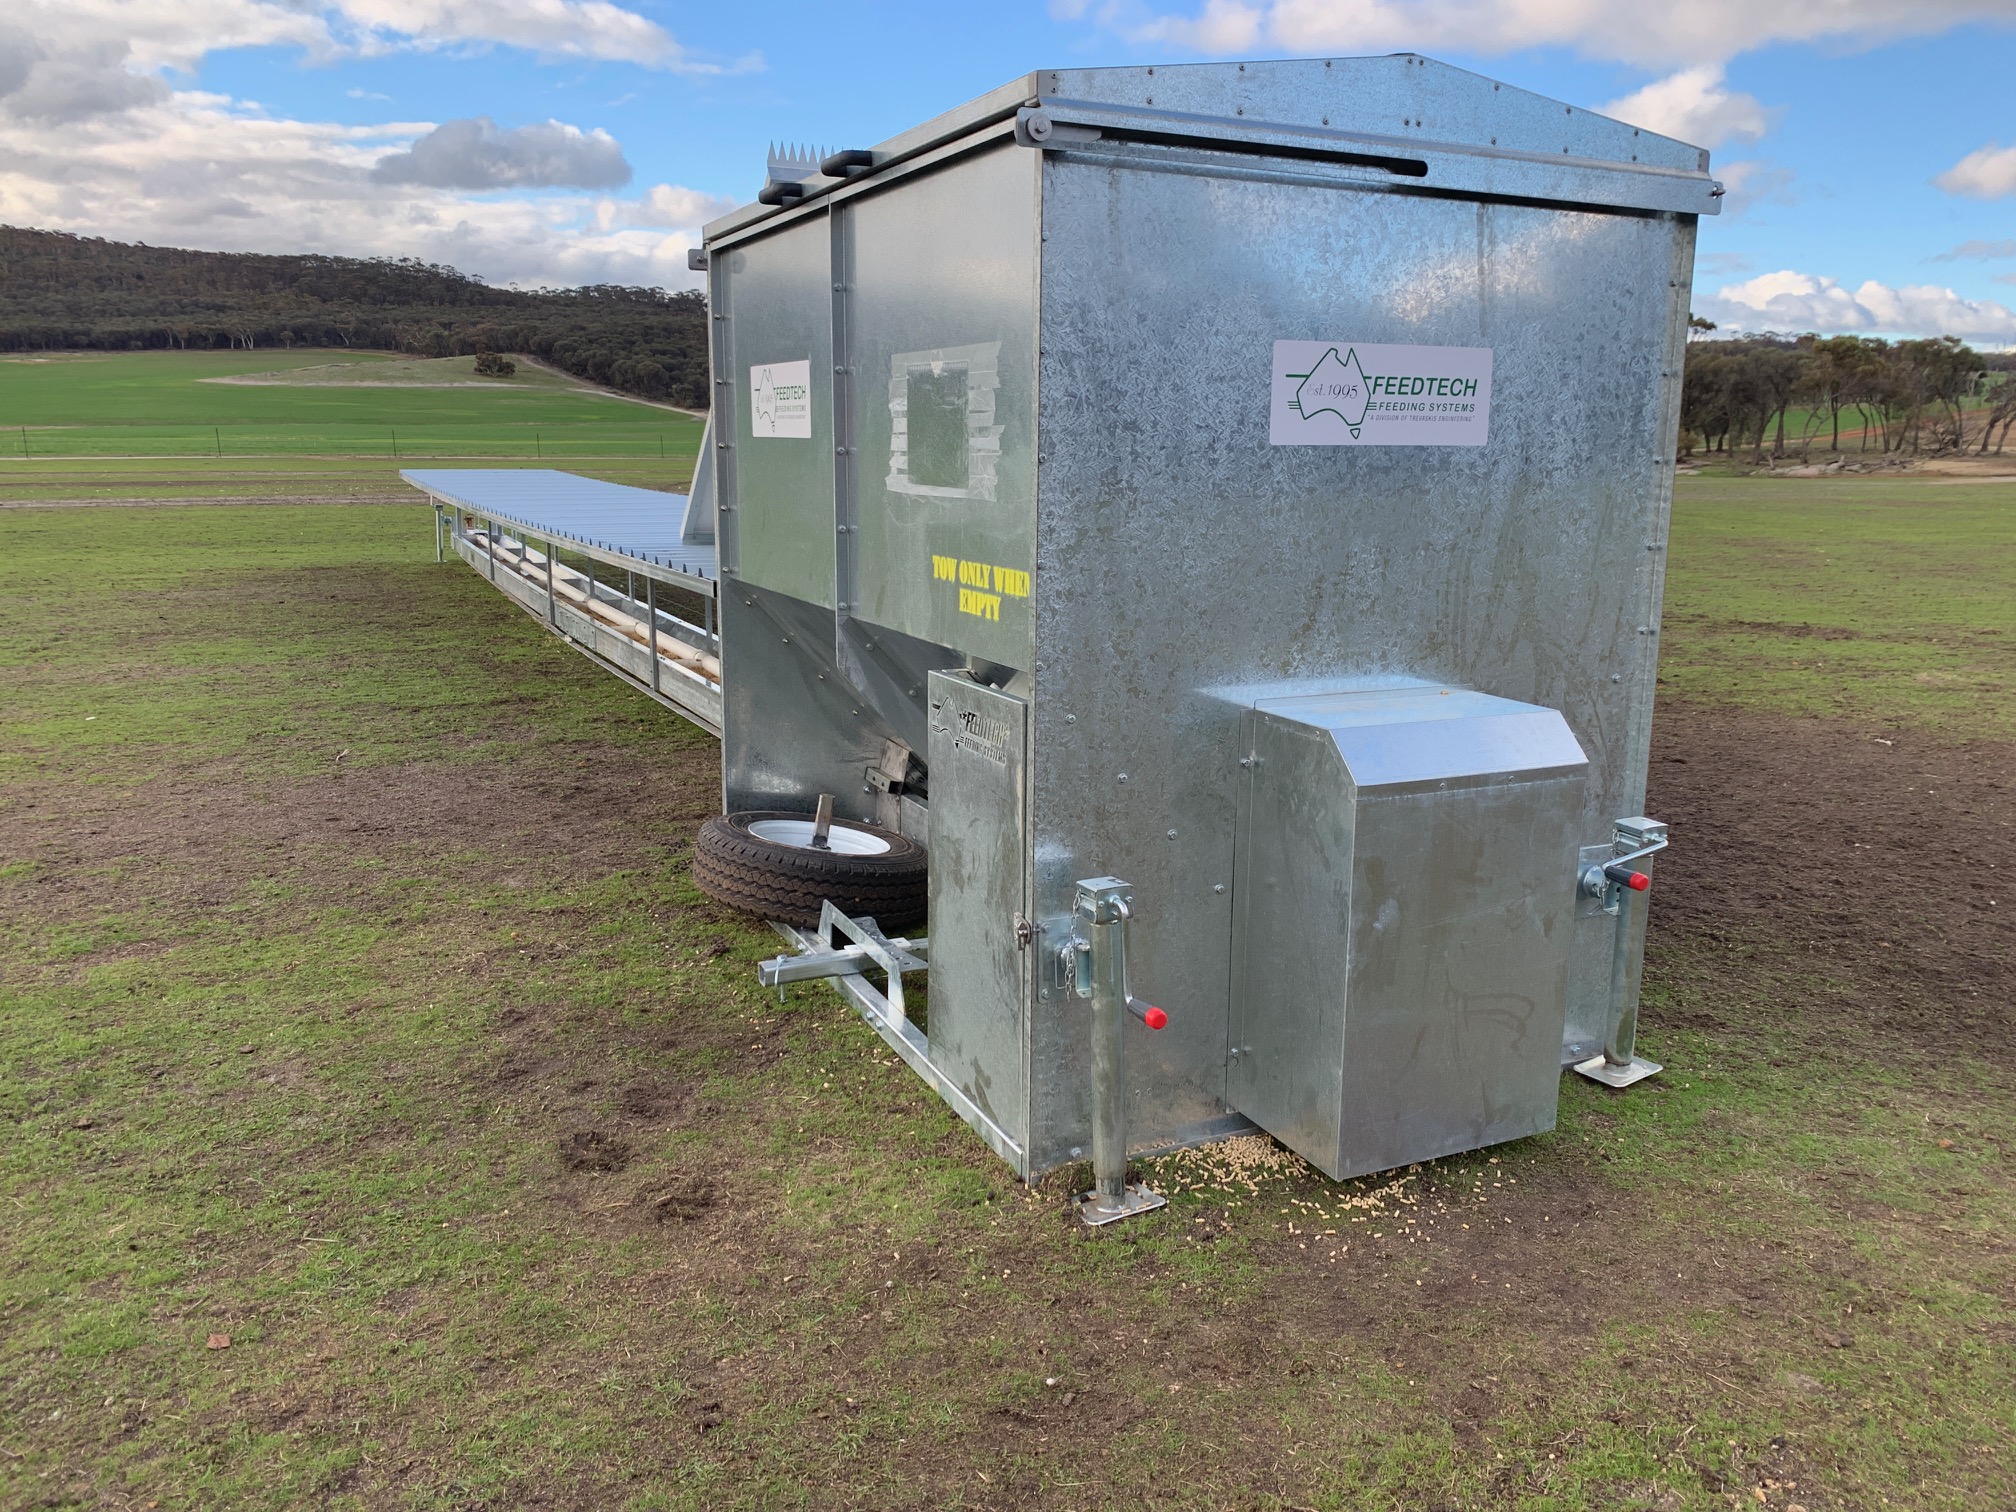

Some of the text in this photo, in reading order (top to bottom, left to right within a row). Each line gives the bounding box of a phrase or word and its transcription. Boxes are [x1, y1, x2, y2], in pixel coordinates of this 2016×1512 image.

[1328, 383, 1358, 399] 1995
[1372, 376, 1478, 397] FEEDTECH
[1378, 401, 1476, 412] FEEDING SYSTEMS
[932, 554, 957, 583] TOW
[958, 560, 991, 589] ONLY
[959, 588, 1001, 621] EMPTY
